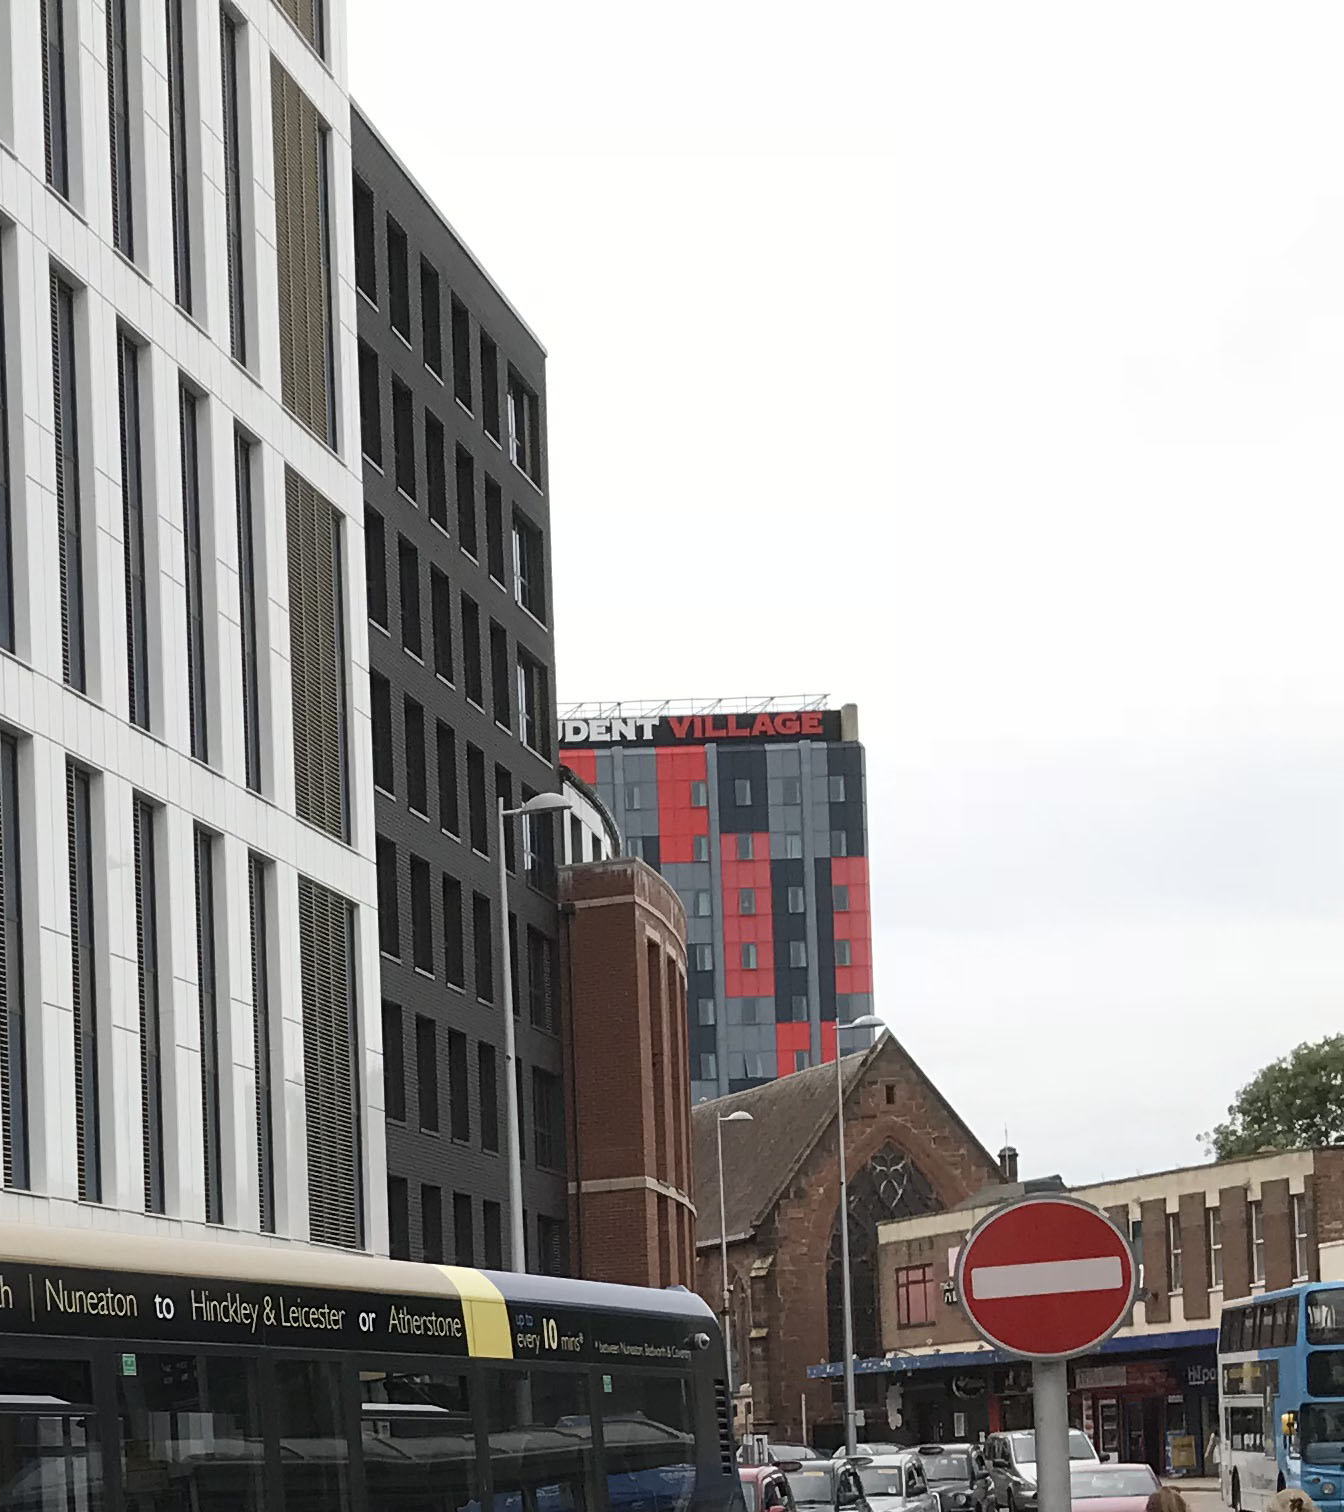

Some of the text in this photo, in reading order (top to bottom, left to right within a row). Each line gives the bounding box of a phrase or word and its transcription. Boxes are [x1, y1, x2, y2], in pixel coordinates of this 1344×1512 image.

[668, 711, 824, 739] VILLAGE
[45, 1278, 138, 1318] Nuneaton
[154, 1294, 175, 1320] to
[191, 1291, 259, 1333] Hinckley
[263, 1302, 277, 1326] &
[281, 1297, 346, 1330] Leicester
[358, 1311, 376, 1332] or
[388, 1306, 463, 1338] Atherstone
[516, 1332, 541, 1354] every
[542, 1317, 558, 1351] 10
